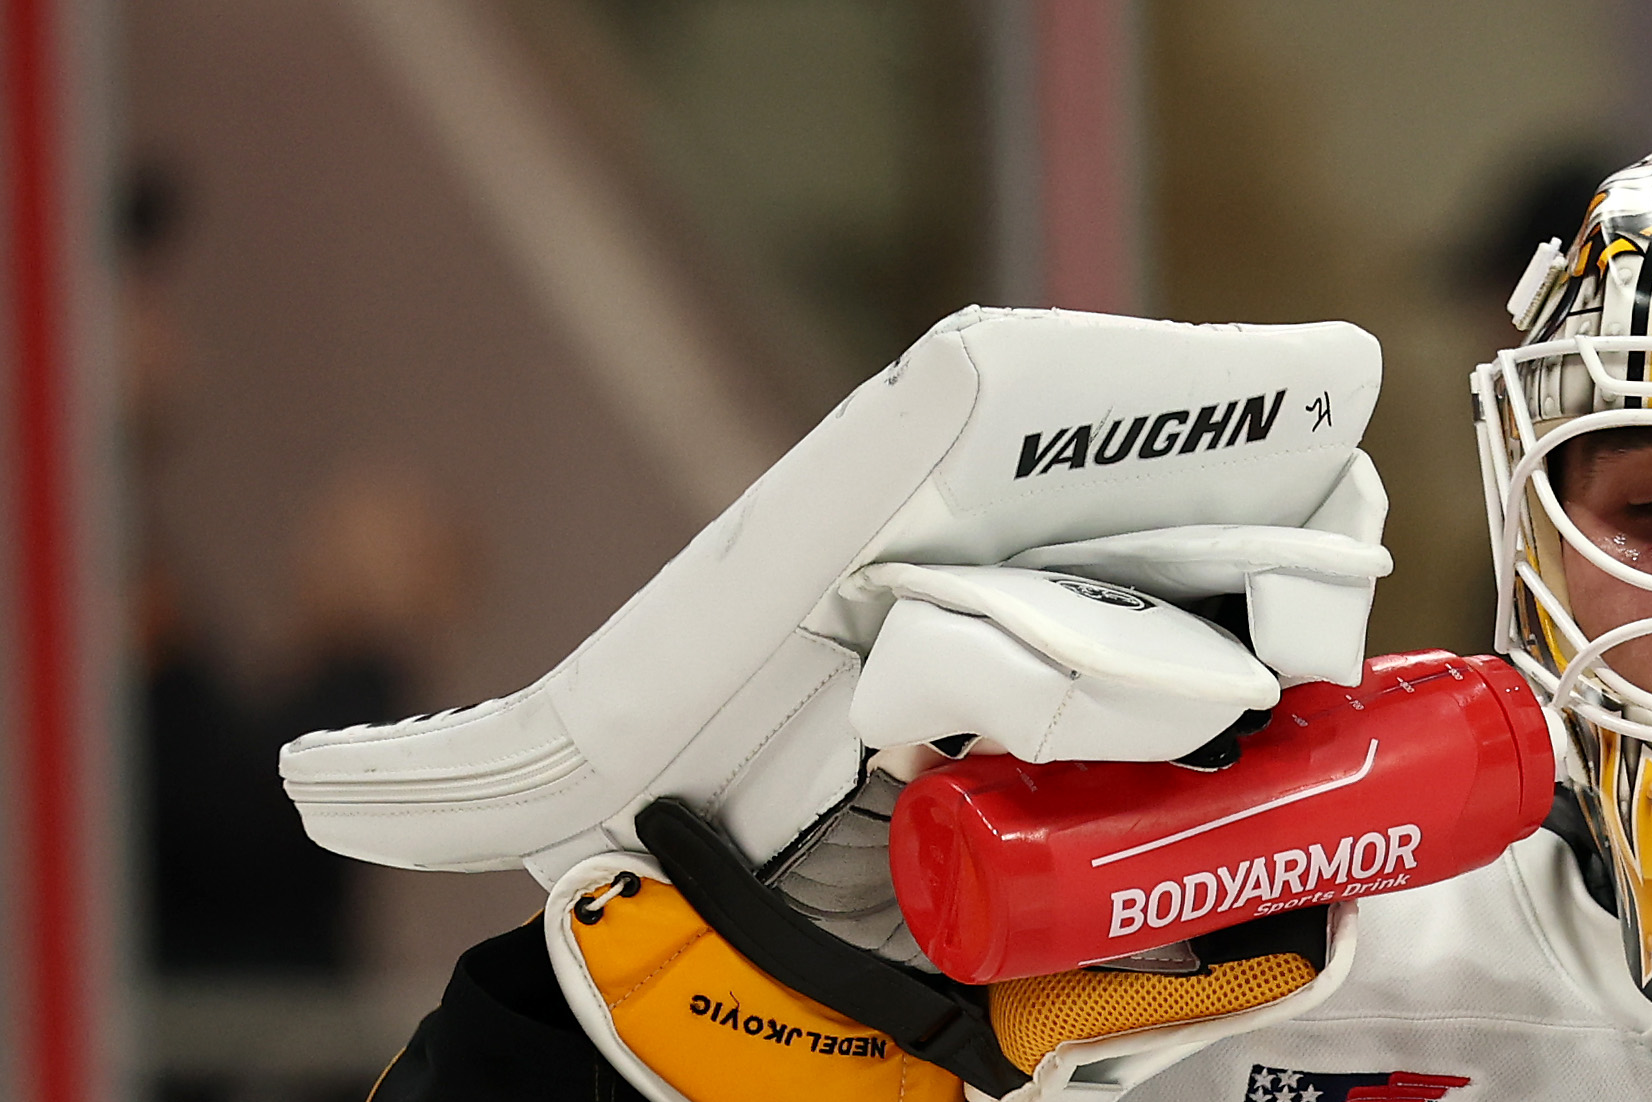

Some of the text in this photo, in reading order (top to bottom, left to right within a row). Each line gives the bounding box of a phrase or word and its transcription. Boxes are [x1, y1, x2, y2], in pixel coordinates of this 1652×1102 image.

[1013, 387, 1289, 480] VAUGHN
[1108, 823, 1421, 938] BODYARMOR
[1254, 873, 1412, 917] Sports Drink
[689, 994, 887, 1060] NEDELJKOVIC
